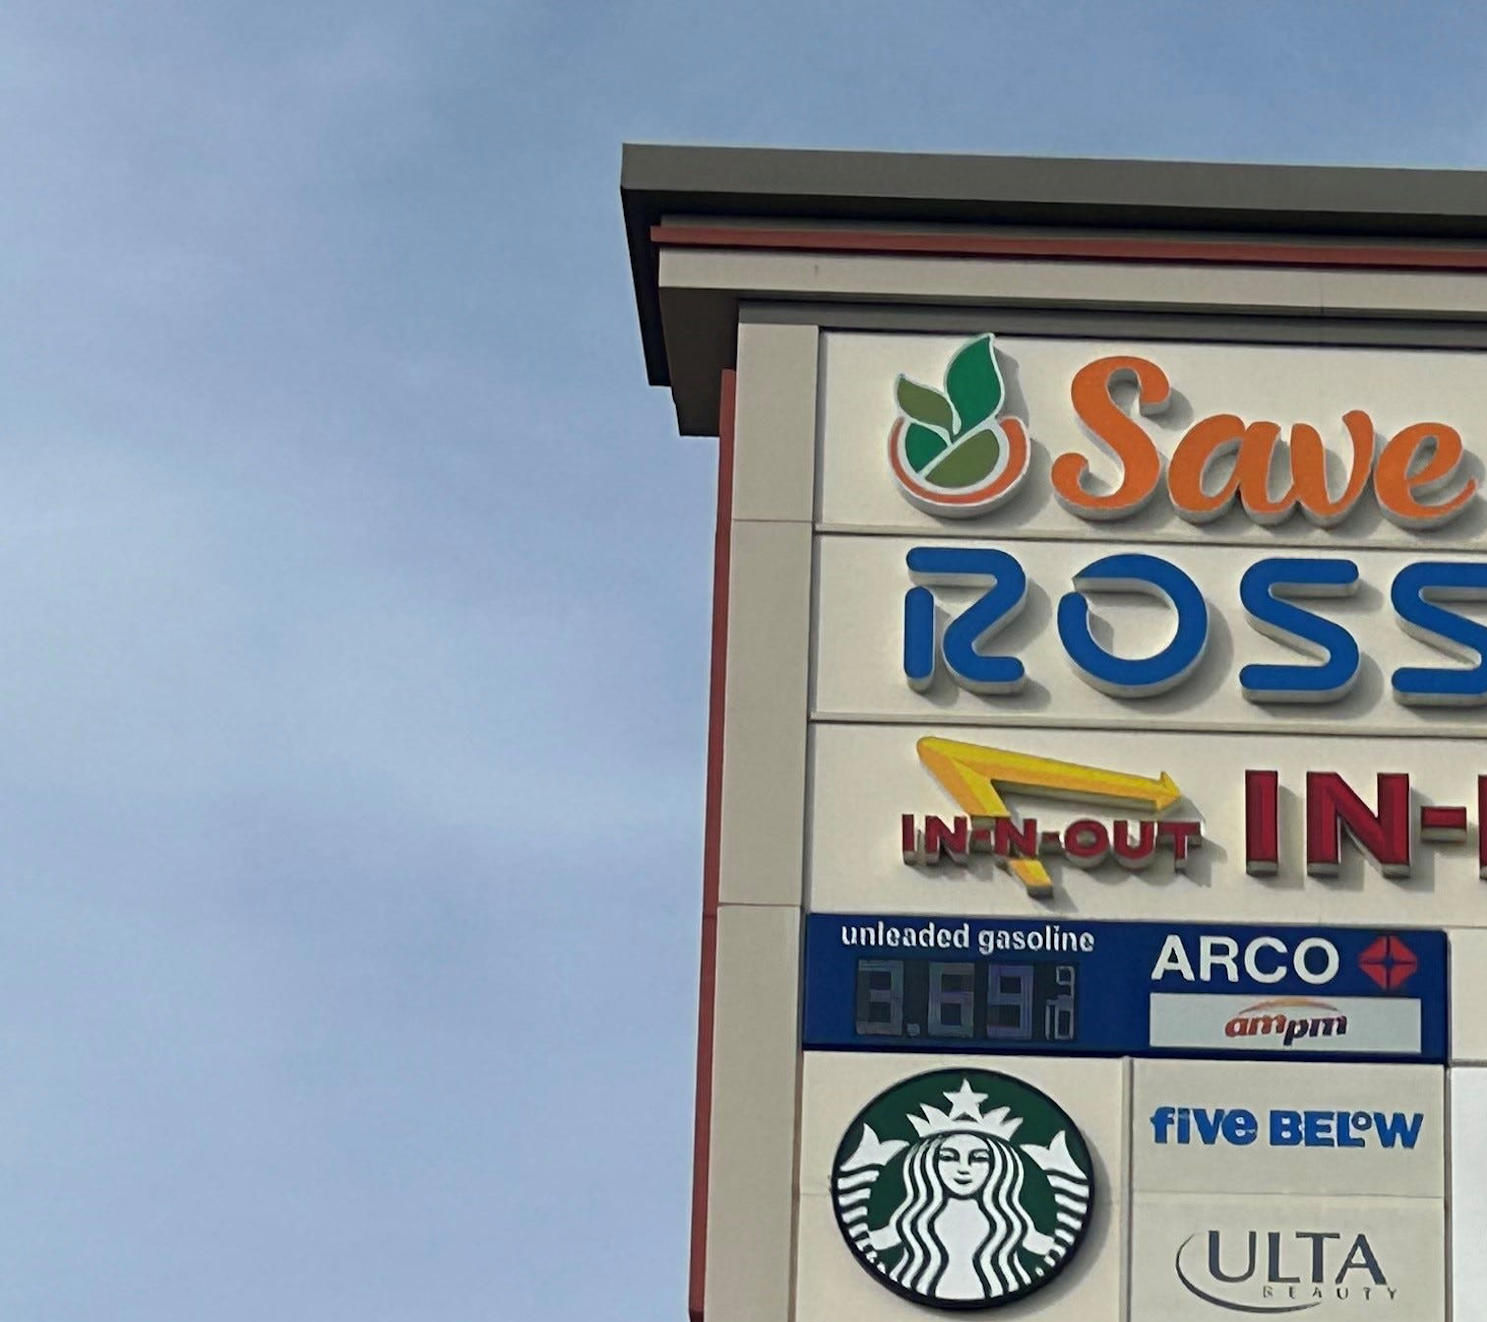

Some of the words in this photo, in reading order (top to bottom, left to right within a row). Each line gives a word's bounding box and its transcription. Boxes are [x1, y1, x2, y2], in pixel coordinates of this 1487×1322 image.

[1050, 354, 1478, 532] Save
[902, 814, 1202, 872] IN-N-OUT
[841, 920, 971, 949] unleaded
[977, 924, 1096, 956] gasoline
[1151, 935, 1340, 985] ARCO
[1224, 1012, 1348, 1047] ampm
[1208, 1230, 1388, 1286] ULTA
[1263, 1284, 1398, 1300] BEAUTY
